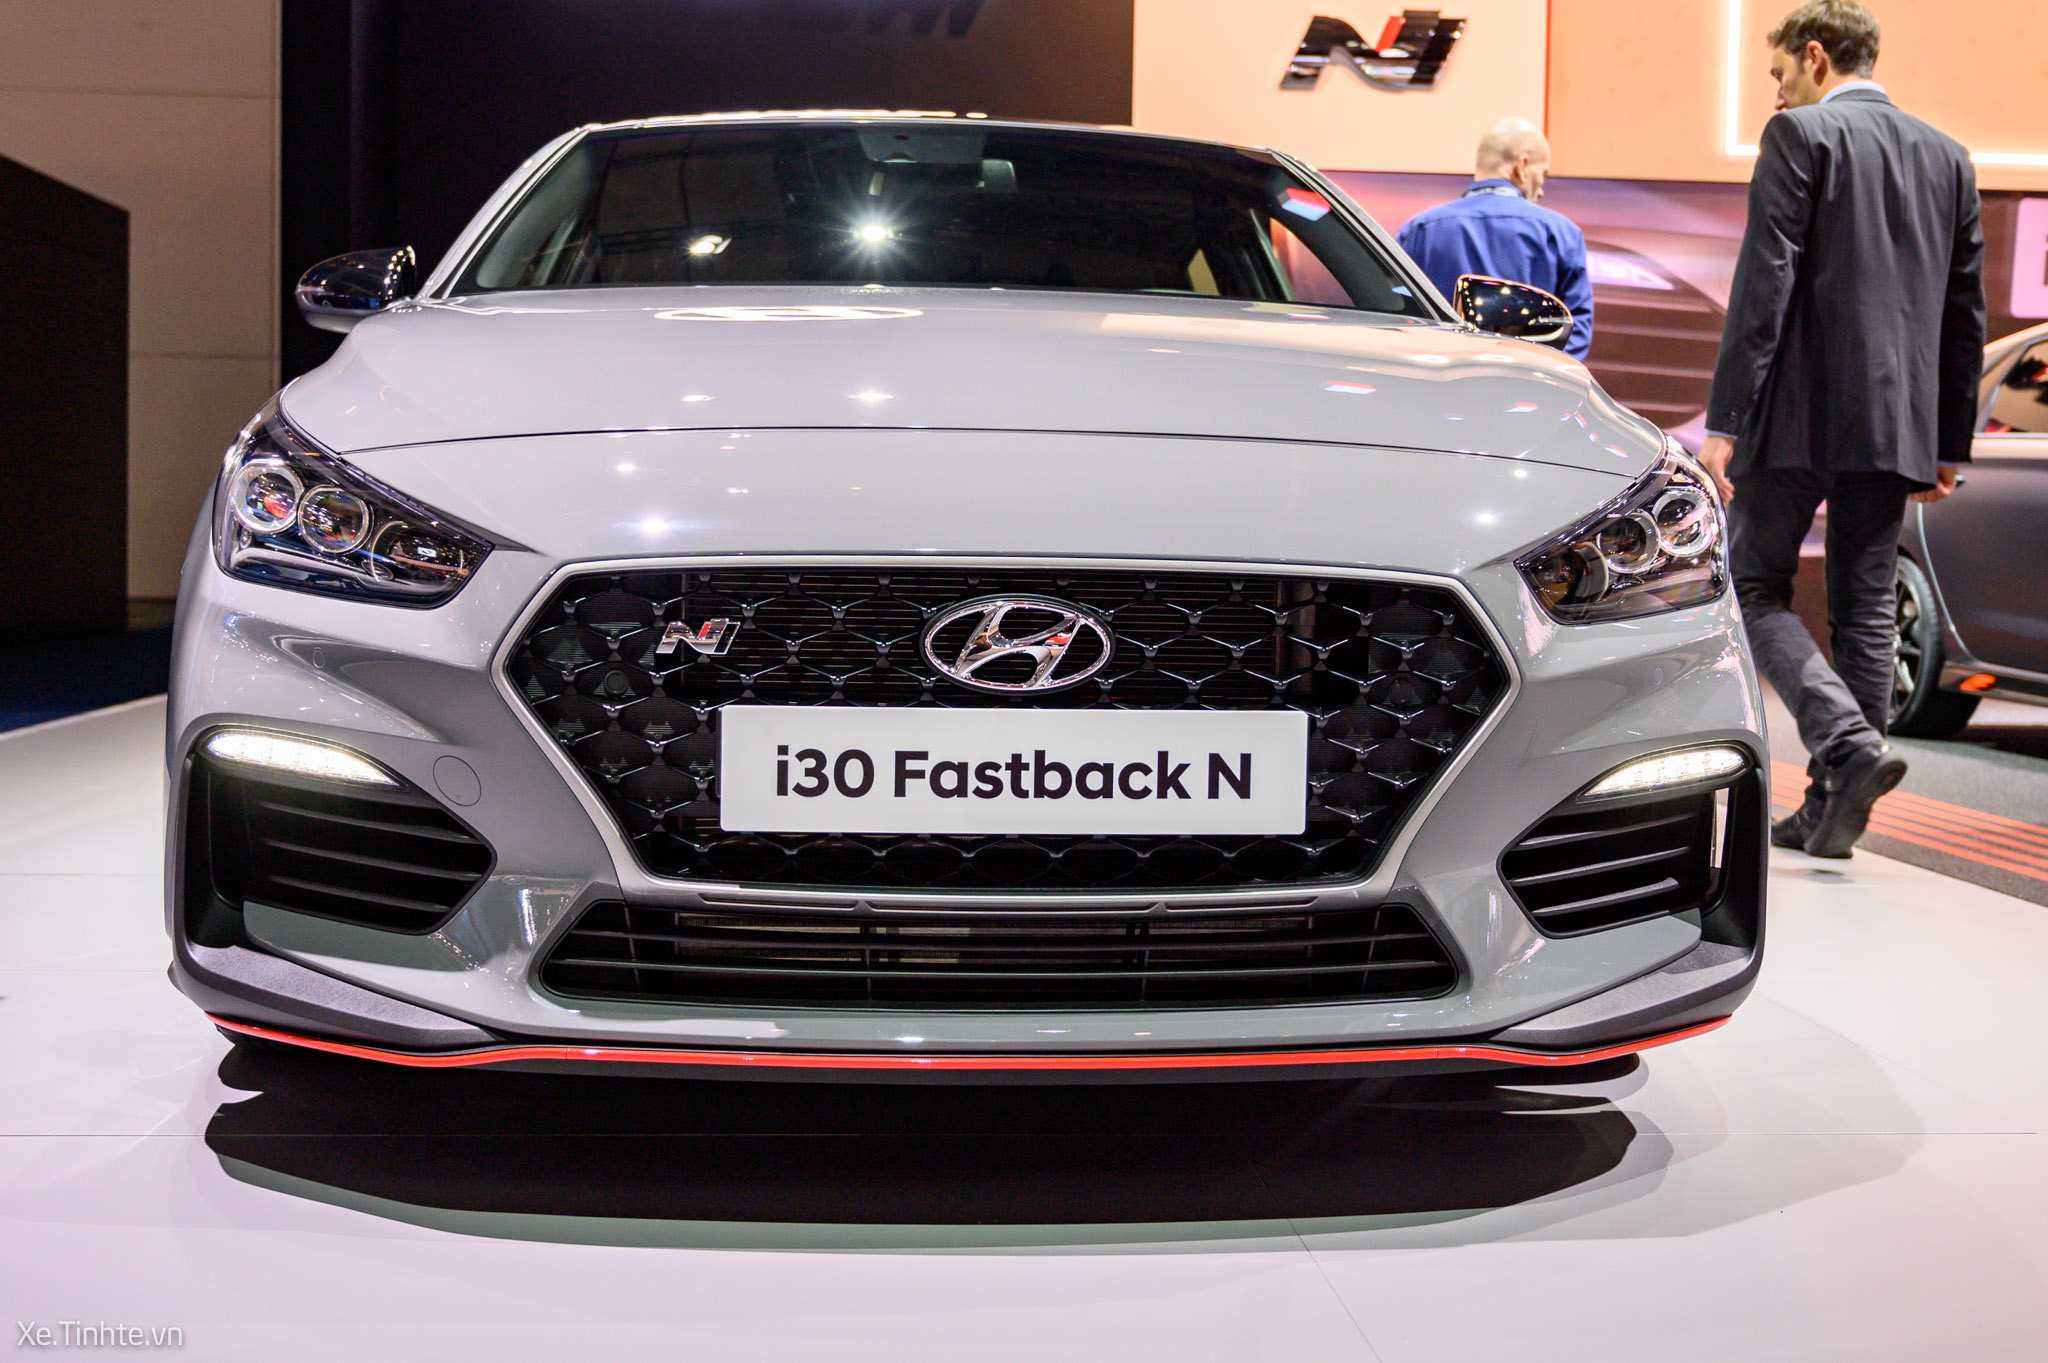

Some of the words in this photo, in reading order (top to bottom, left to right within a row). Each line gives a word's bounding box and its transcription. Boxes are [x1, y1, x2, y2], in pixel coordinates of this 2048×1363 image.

[776, 744, 875, 798] i30
[893, 750, 1192, 800] Fastback
[1207, 752, 1252, 800] N
